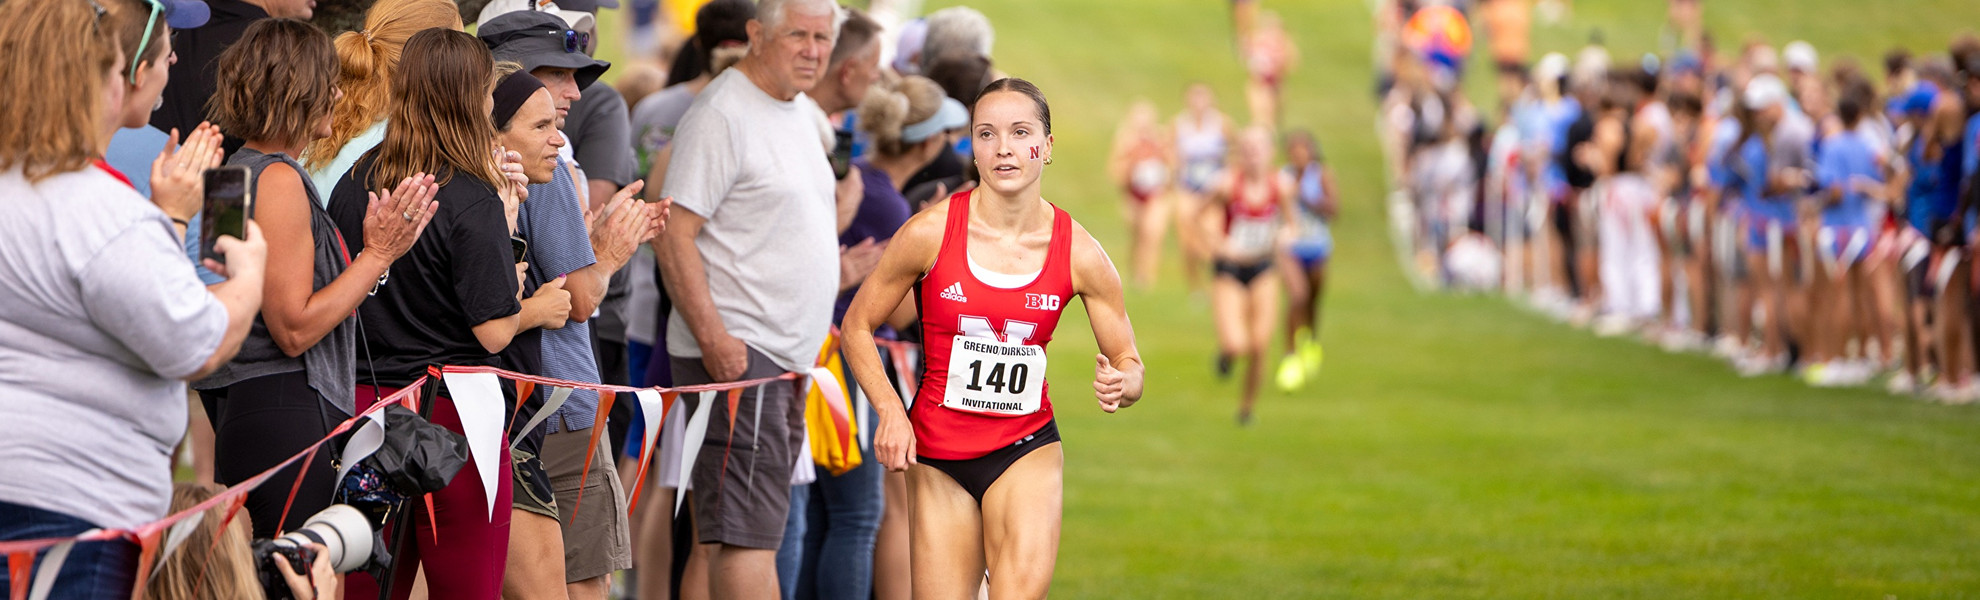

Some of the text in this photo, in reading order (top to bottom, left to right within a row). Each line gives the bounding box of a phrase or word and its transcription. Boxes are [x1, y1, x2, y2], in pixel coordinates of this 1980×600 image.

[1029, 145, 1039, 160] N
[940, 290, 967, 303] adidas
[963, 340, 1037, 357] GREENO/DIRKSEN
[966, 359, 1028, 395] 140
[962, 397, 1023, 411] INVITATIONAL
